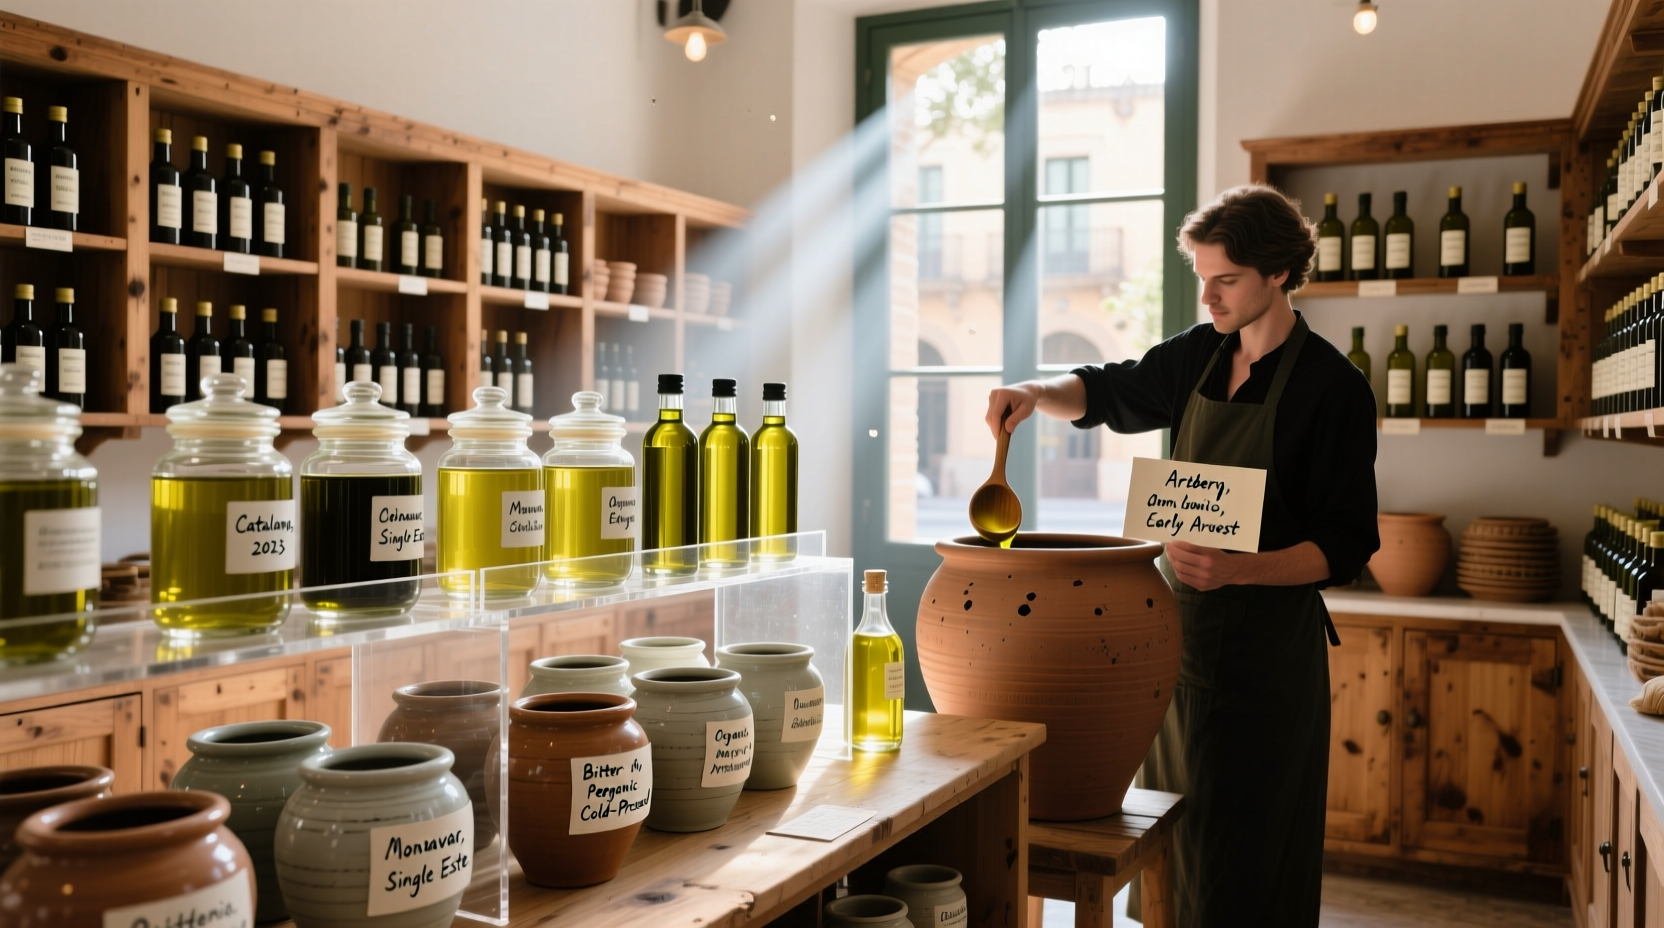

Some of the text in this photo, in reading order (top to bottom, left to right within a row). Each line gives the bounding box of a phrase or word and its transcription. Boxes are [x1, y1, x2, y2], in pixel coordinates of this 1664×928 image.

[1146, 512, 1183, 536] Early
[251, 538, 286, 556] 2023
[583, 763, 624, 781] Bitter
[385, 864, 433, 898] Single
